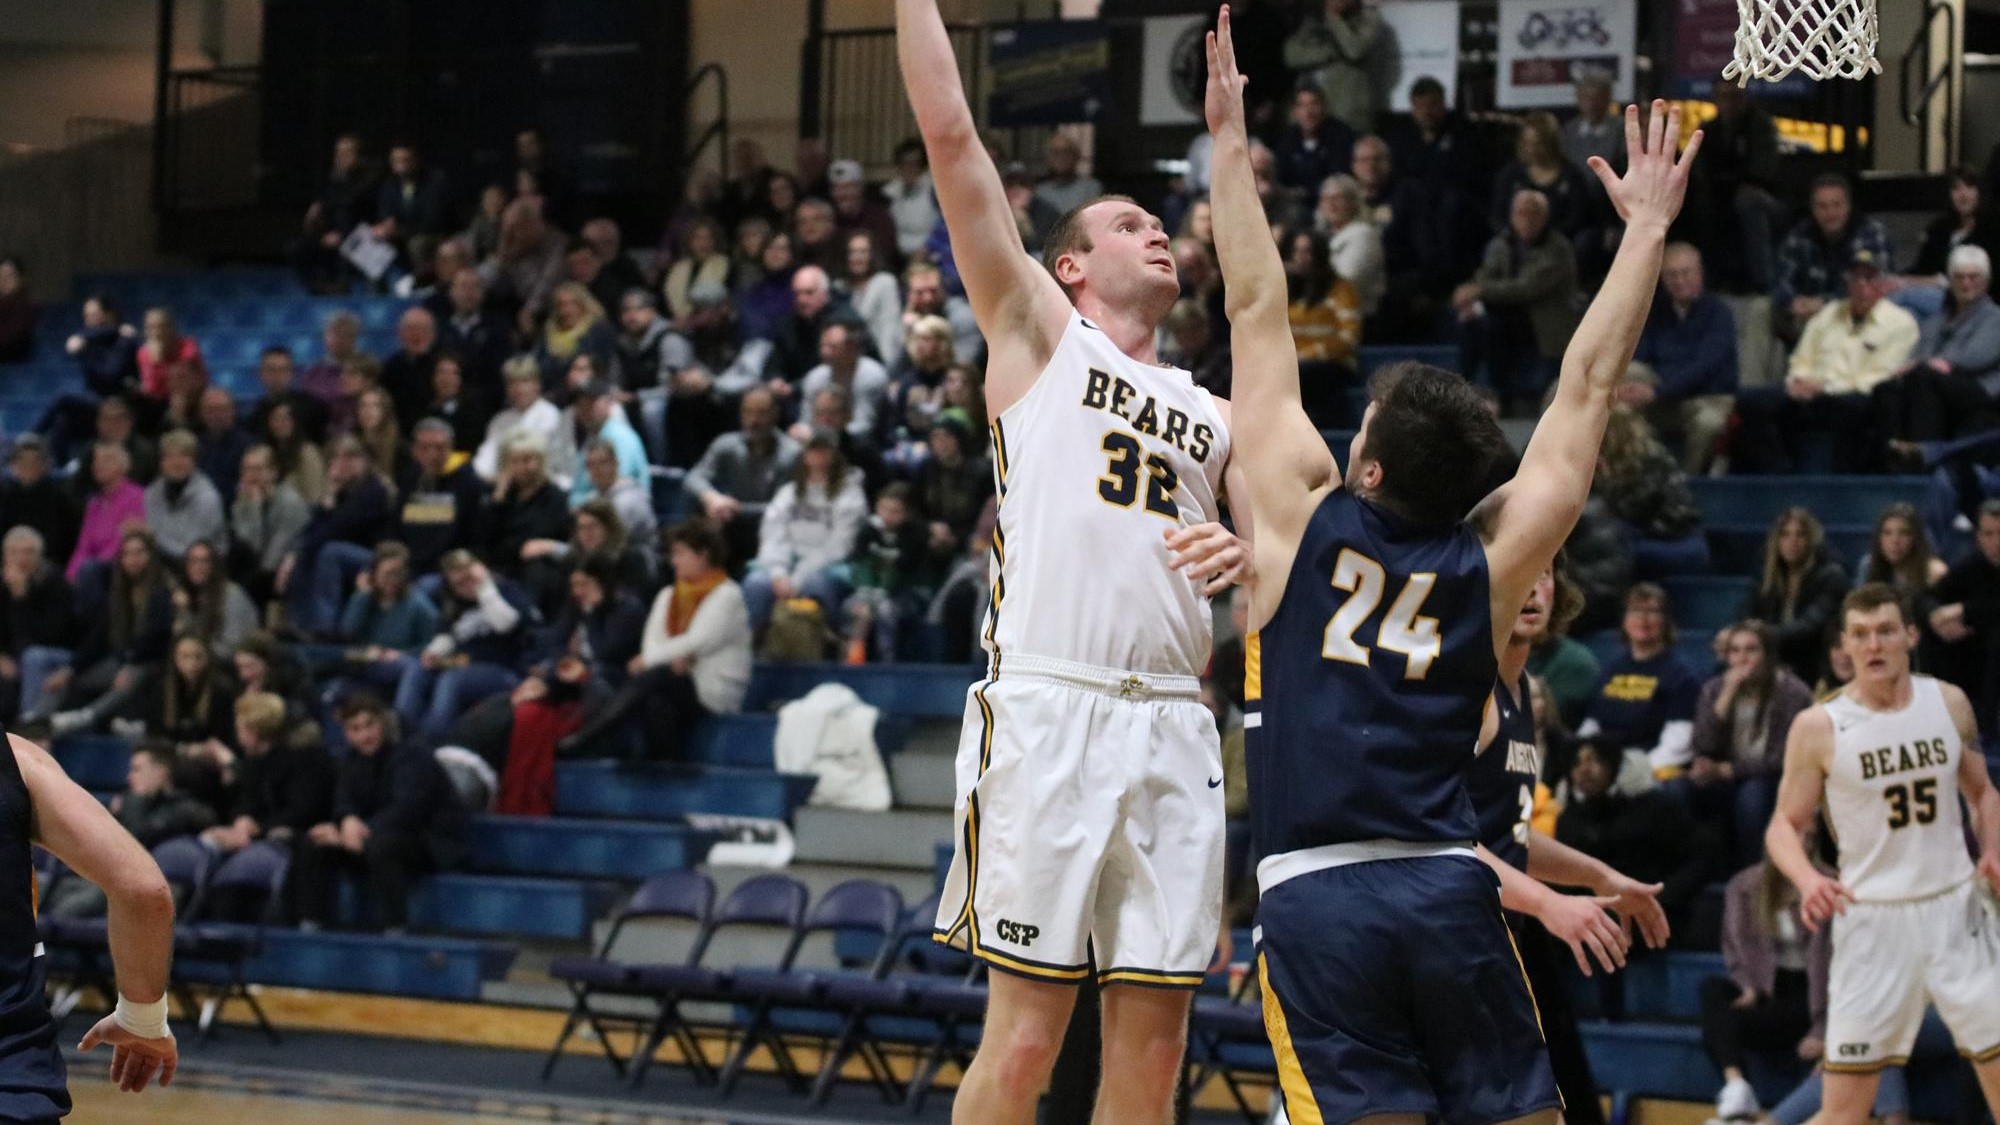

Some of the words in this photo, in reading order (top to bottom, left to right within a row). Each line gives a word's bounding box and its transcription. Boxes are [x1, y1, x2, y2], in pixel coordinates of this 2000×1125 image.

[1082, 366, 1214, 464] BEARS
[1096, 428, 1181, 523] 32
[1321, 546, 1442, 680] 24
[1859, 737, 1948, 779] BEARS
[1883, 776, 1937, 830] 35
[996, 918, 1040, 947] CSP
